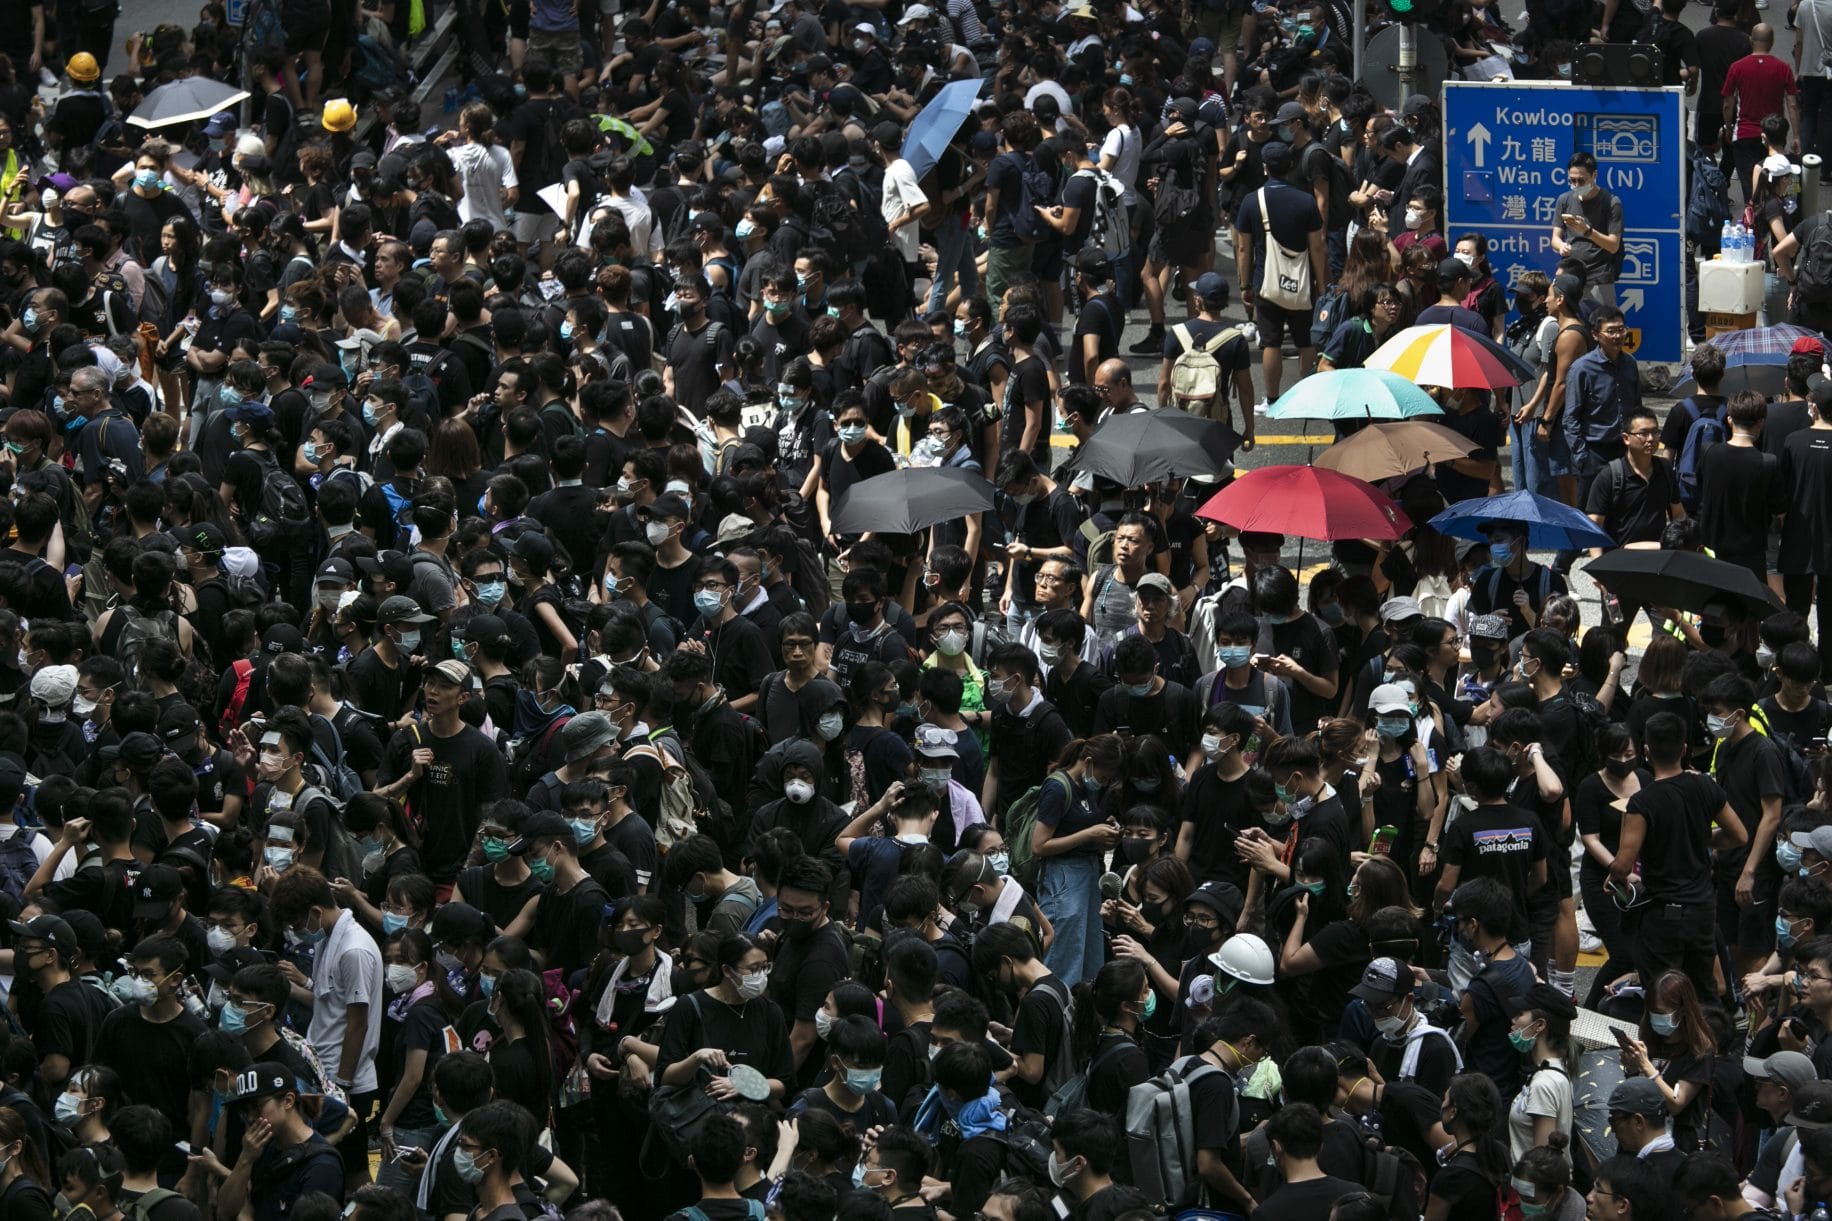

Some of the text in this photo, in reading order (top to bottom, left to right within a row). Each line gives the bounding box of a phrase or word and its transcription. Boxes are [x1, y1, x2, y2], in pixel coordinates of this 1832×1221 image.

[1496, 107, 1588, 127] Kowloon
[1500, 136, 1557, 163] 九龍
[1597, 140, 1612, 155] 中
[1638, 140, 1652, 156] C
[1497, 166, 1542, 185] Wan
[1606, 166, 1644, 191] (N)
[1502, 195, 1555, 221] 灣仔
[1487, 235, 1530, 253] orth
[1280, 275, 1298, 292] Lee
[1479, 840, 1528, 855] patagonia
